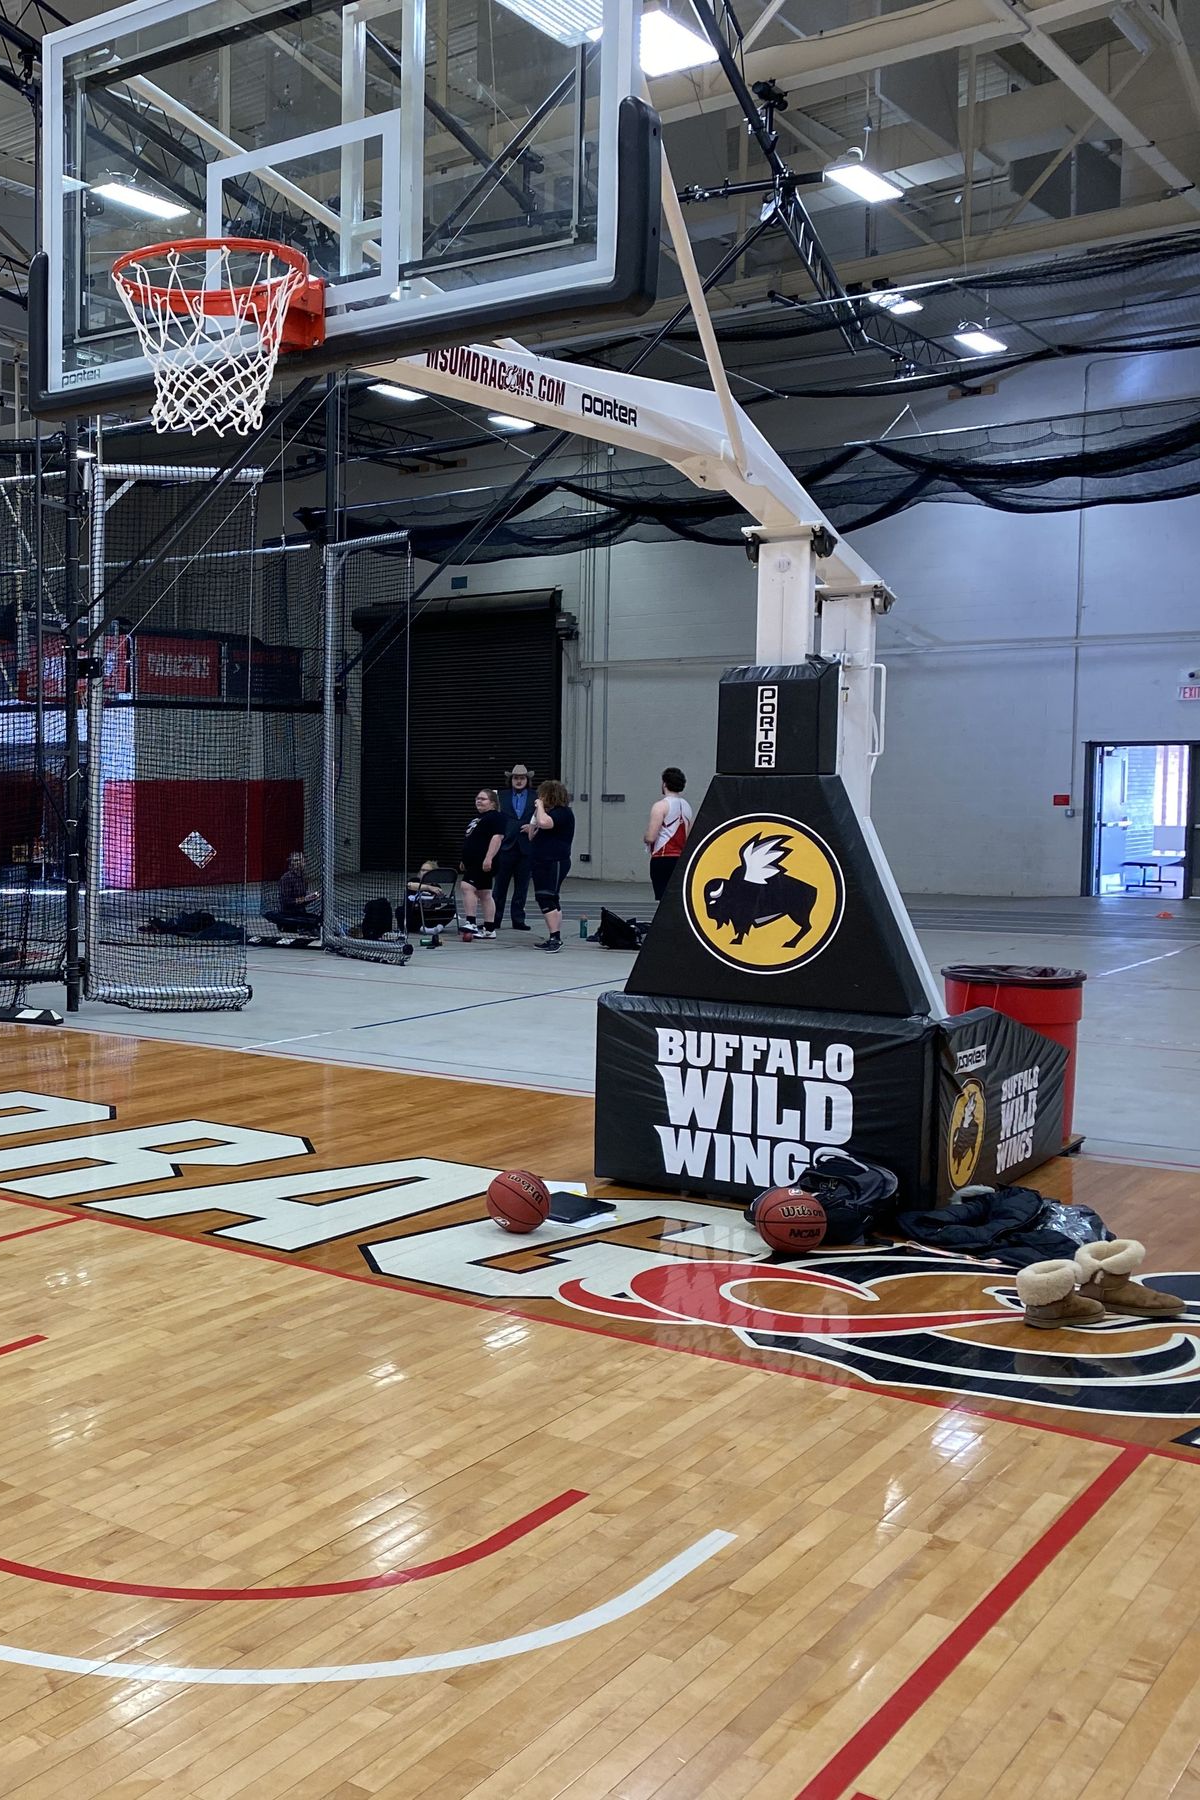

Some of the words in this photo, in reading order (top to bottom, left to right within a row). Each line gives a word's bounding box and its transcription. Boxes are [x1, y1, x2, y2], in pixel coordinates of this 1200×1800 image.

[655, 1027, 855, 1082] BUFFALO
[654, 1064, 854, 1146] WILD
[1001, 1065, 1040, 1102] BUFFALO
[1000, 1090, 1038, 1140] WILD
[653, 1124, 850, 1188] WING
[996, 1128, 1034, 1174] WINGS
[507, 1174, 544, 1205] Wilson
[780, 1205, 824, 1218] Wilson
[789, 1228, 821, 1238] NCAA
